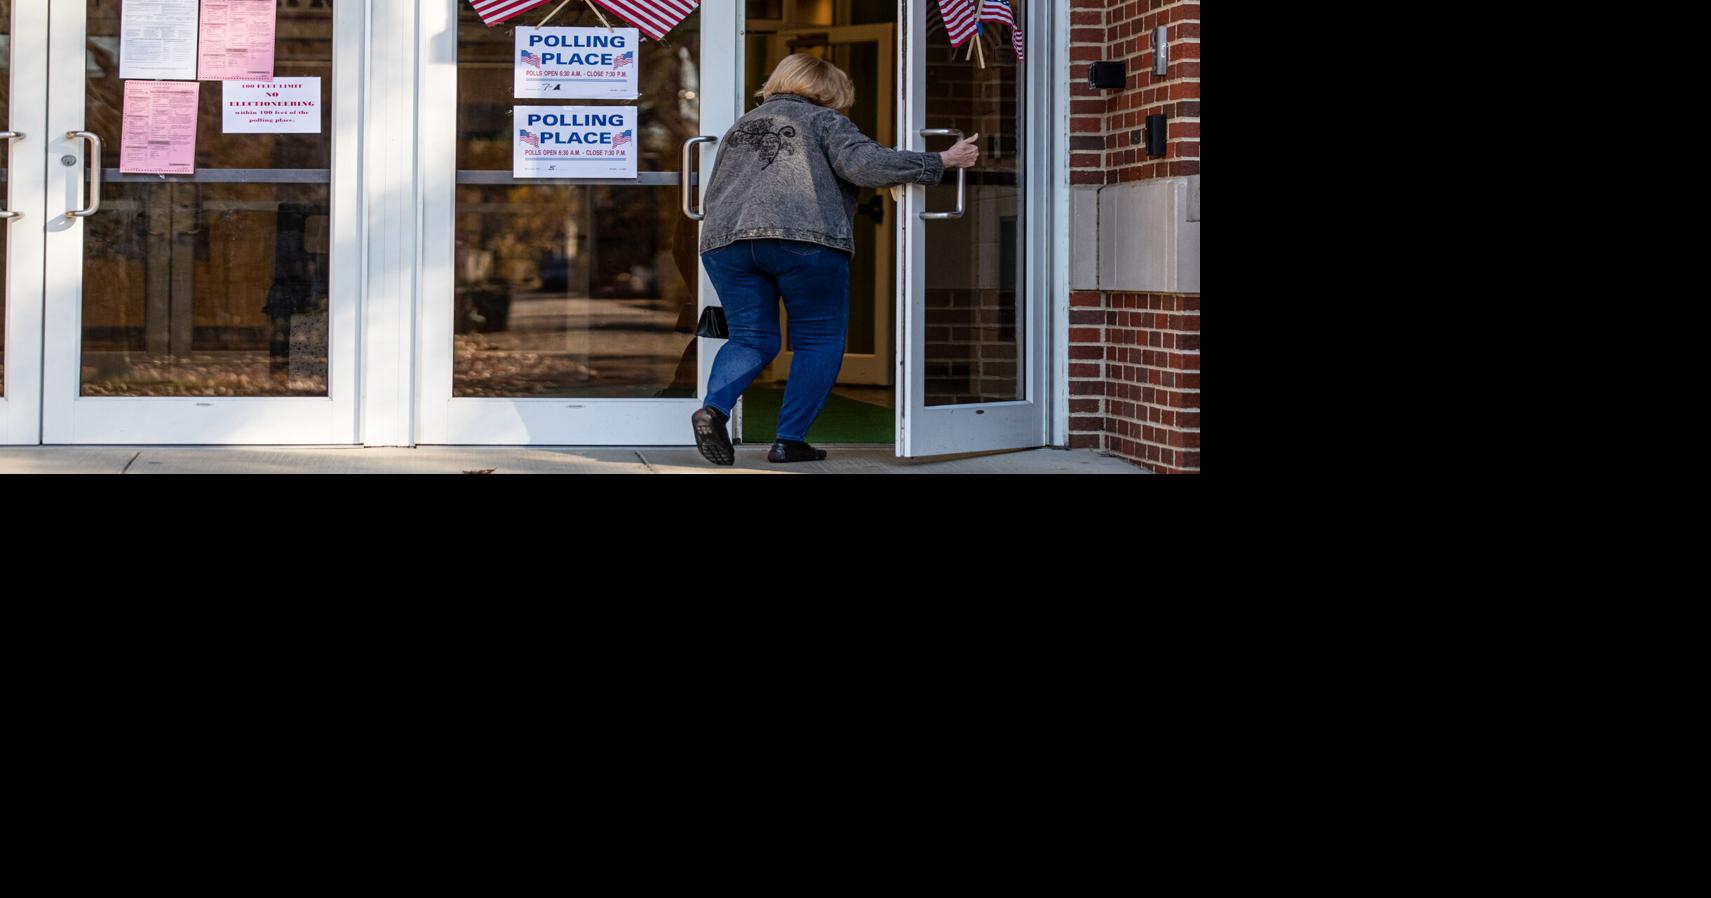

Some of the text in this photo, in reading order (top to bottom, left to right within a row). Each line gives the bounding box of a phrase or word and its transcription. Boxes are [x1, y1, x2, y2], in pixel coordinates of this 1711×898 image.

[529, 35, 625, 48] POLLING
[542, 53, 612, 65] PLACE
[528, 114, 624, 126] POLLING
[540, 132, 611, 144] PLACE
